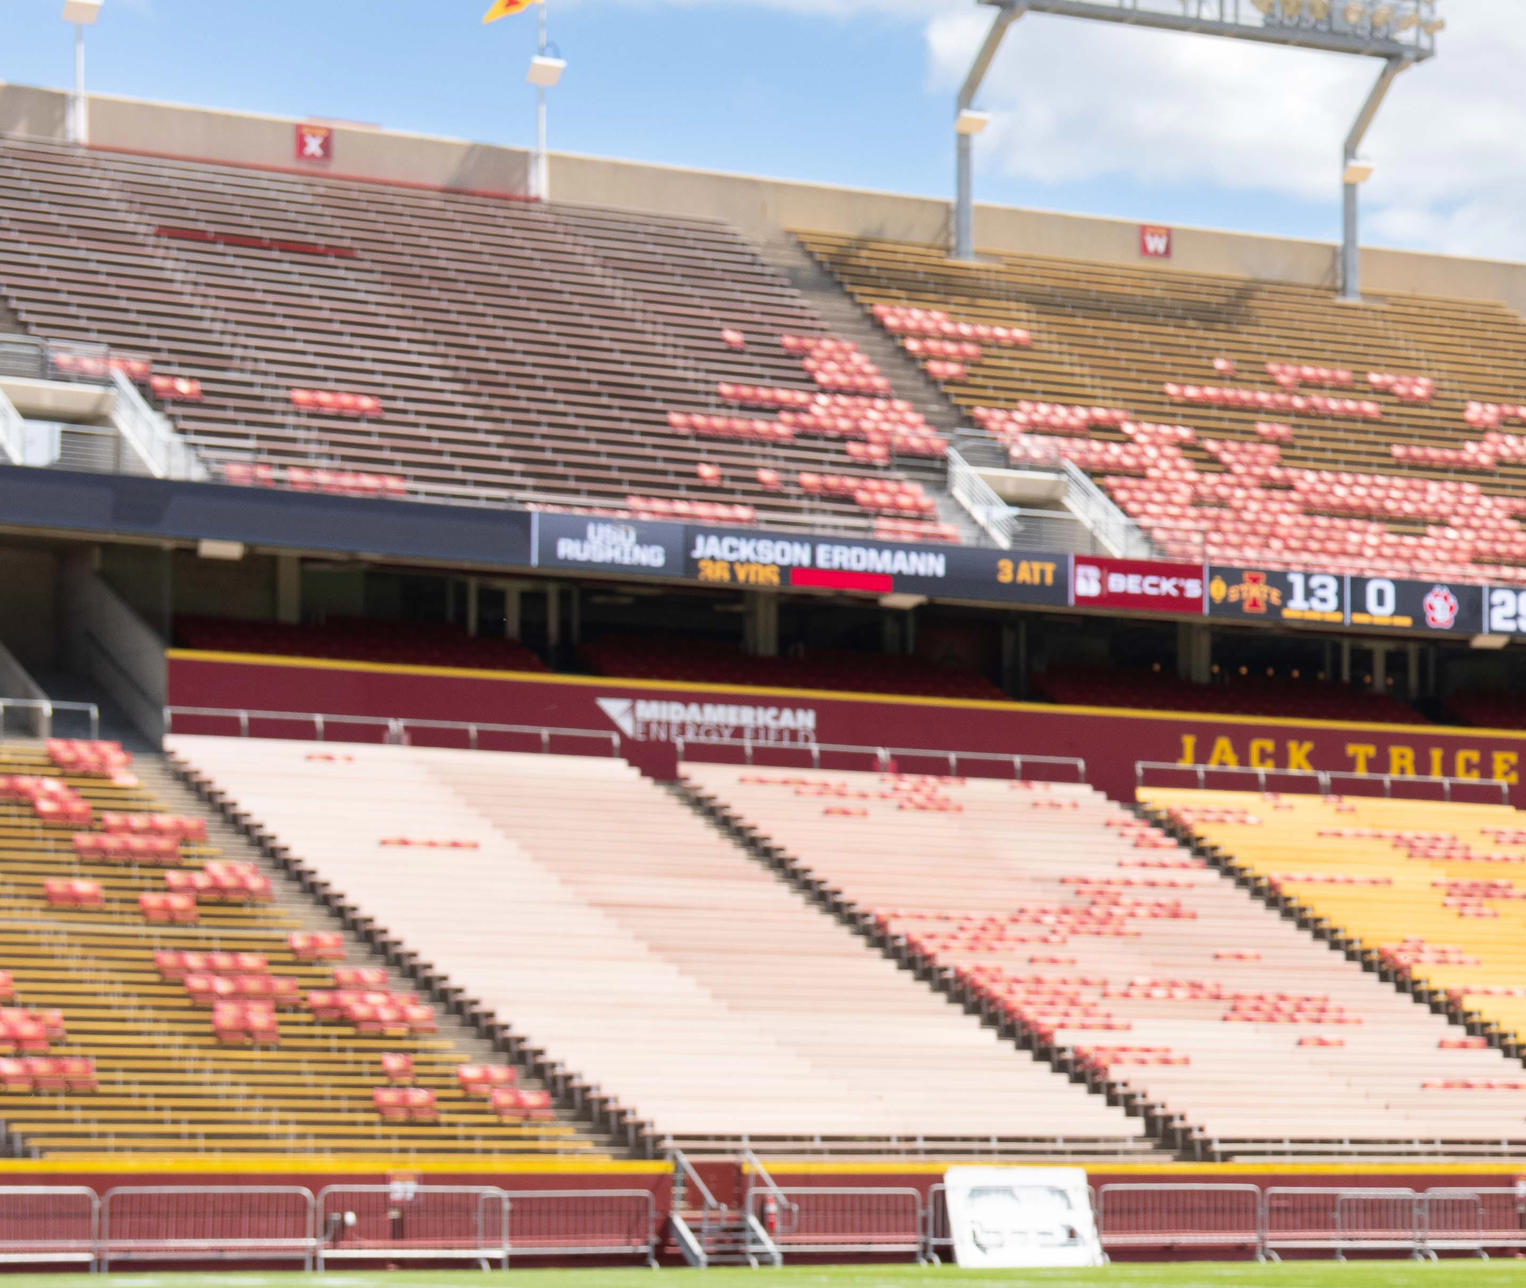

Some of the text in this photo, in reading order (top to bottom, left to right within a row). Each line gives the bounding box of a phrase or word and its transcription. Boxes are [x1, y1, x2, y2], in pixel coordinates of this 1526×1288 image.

[1144, 233, 1167, 254] W
[557, 538, 665, 567] RUSHING
[691, 535, 946, 577] JACKSON ERDMANN
[997, 560, 1056, 586] 3 ATT
[1107, 573, 1202, 598] BECK'S
[1287, 573, 1339, 612] 13
[1366, 578, 1395, 617] 0
[634, 699, 816, 730] MIDAMERICAN
[636, 721, 735, 742] ENERGY
[1176, 735, 1314, 772] JACK
[1346, 743, 1519, 785] TRICE
